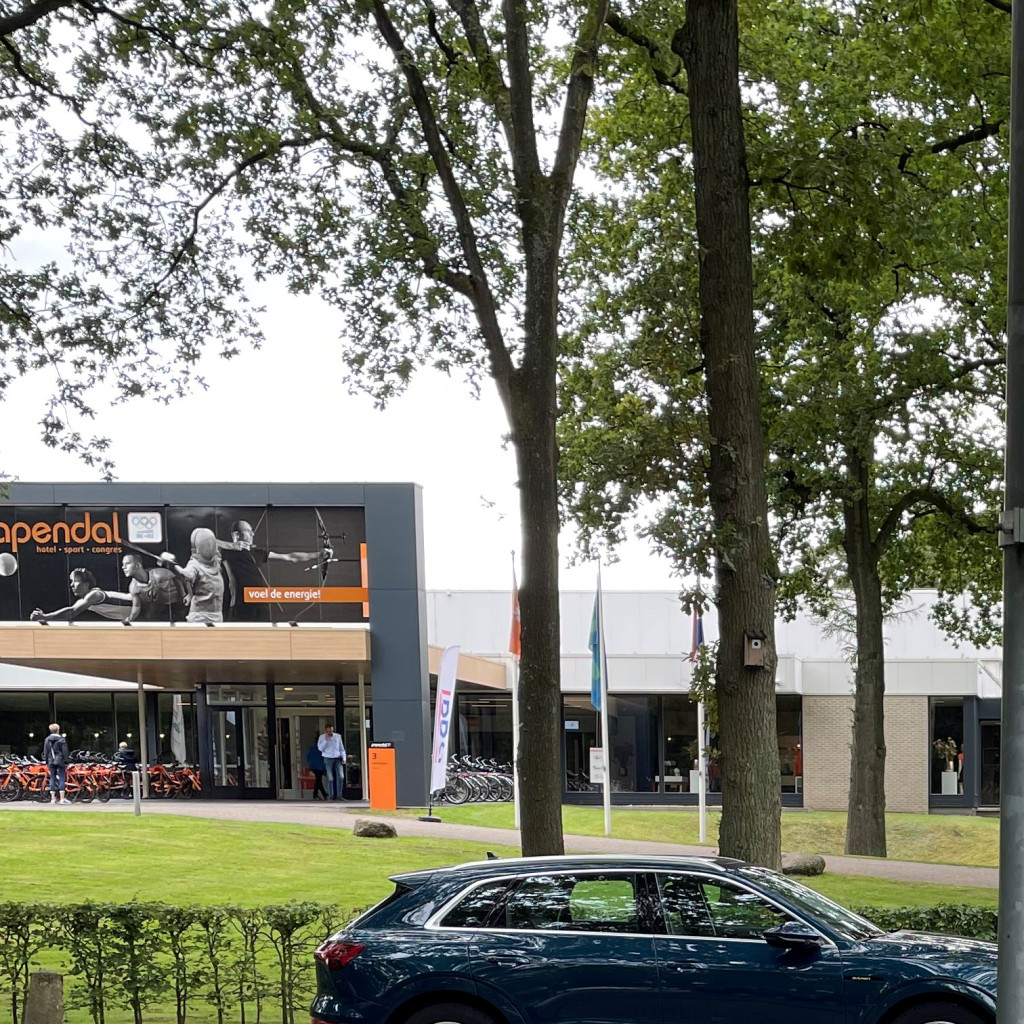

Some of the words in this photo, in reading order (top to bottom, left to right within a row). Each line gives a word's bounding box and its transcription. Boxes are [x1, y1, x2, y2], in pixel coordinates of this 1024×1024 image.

[36, 545, 57, 553] hotel
[63, 545, 85, 555] sport
[91, 546, 123, 555] congres
[248, 588, 269, 599] voel
[270, 589, 282, 599] de
[283, 589, 321, 601] energie!
